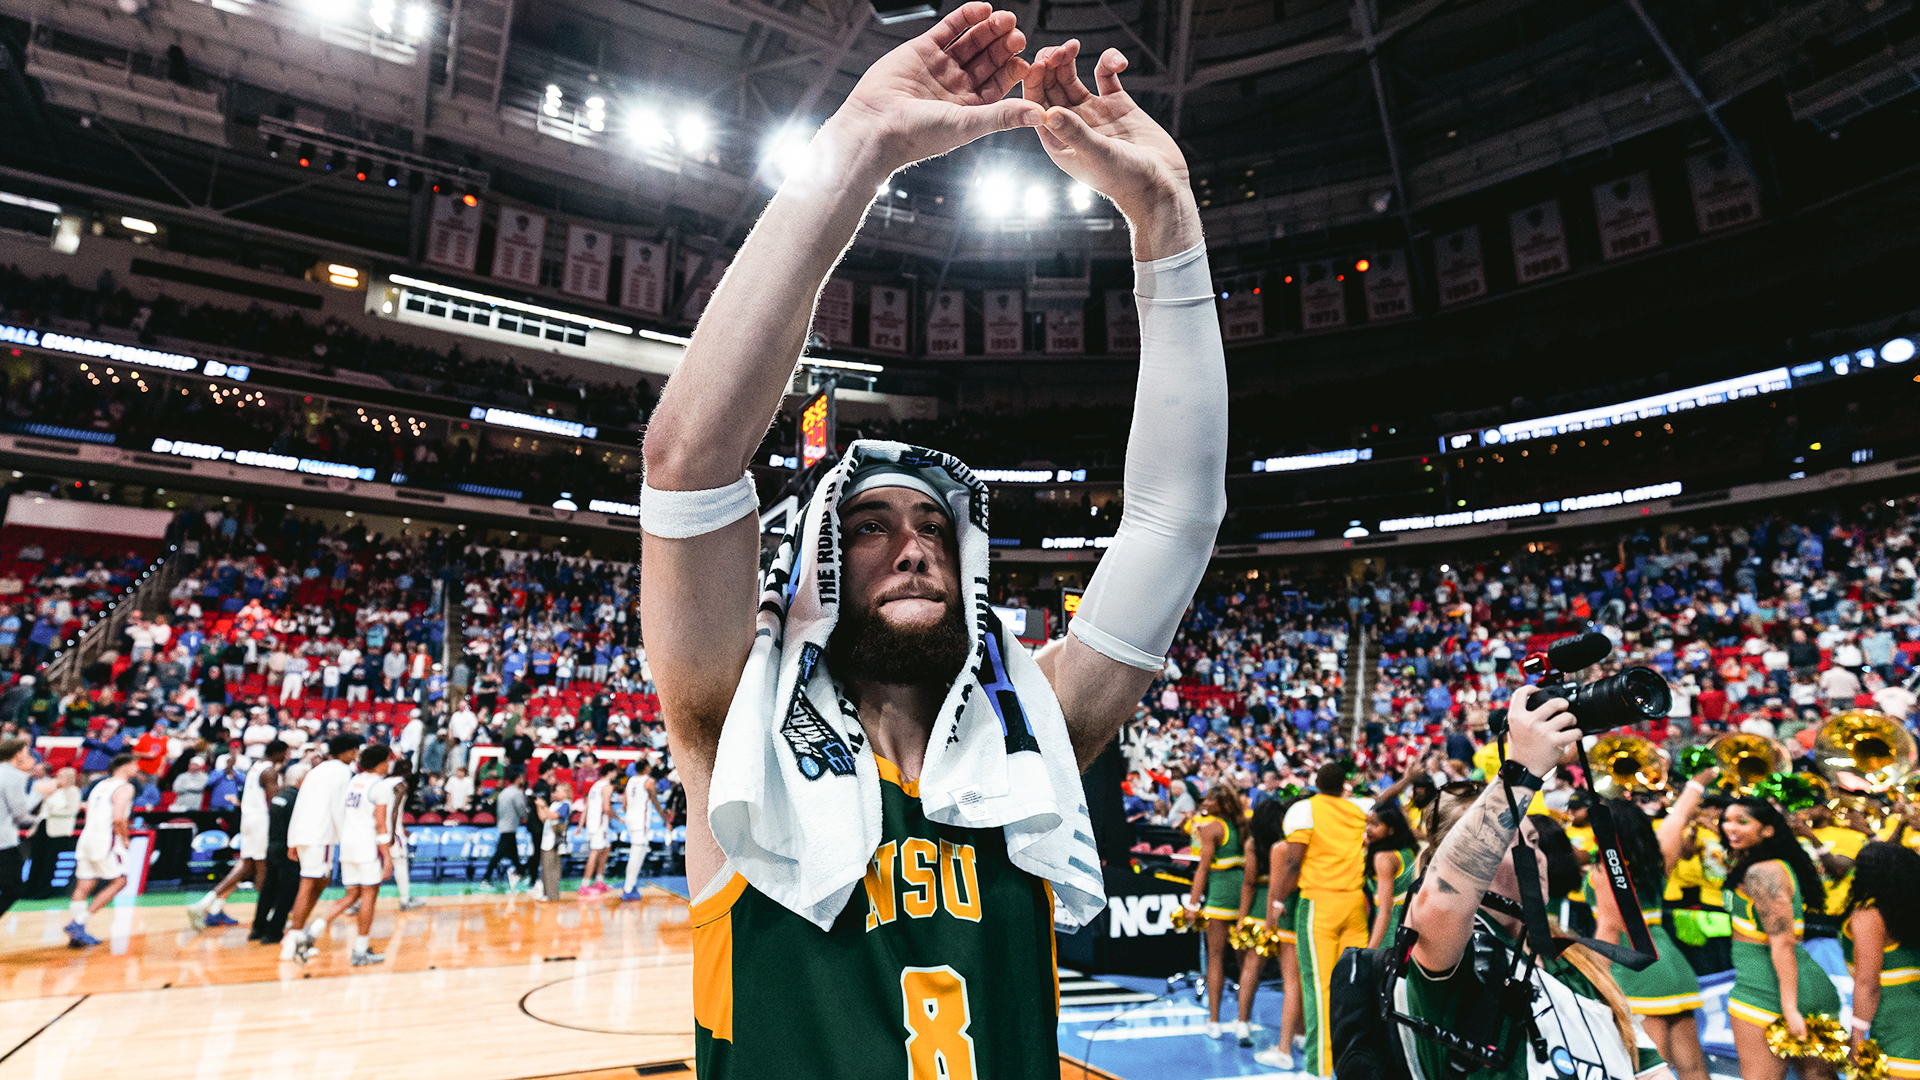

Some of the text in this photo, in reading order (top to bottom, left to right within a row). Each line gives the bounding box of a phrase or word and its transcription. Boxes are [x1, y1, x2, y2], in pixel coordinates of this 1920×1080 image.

[817, 510, 835, 564] ROAD
[817, 569, 837, 608] THE
[864, 837, 982, 933] NSU
[1606, 849, 1628, 889] EOS R7
[901, 965, 979, 1080] 8
